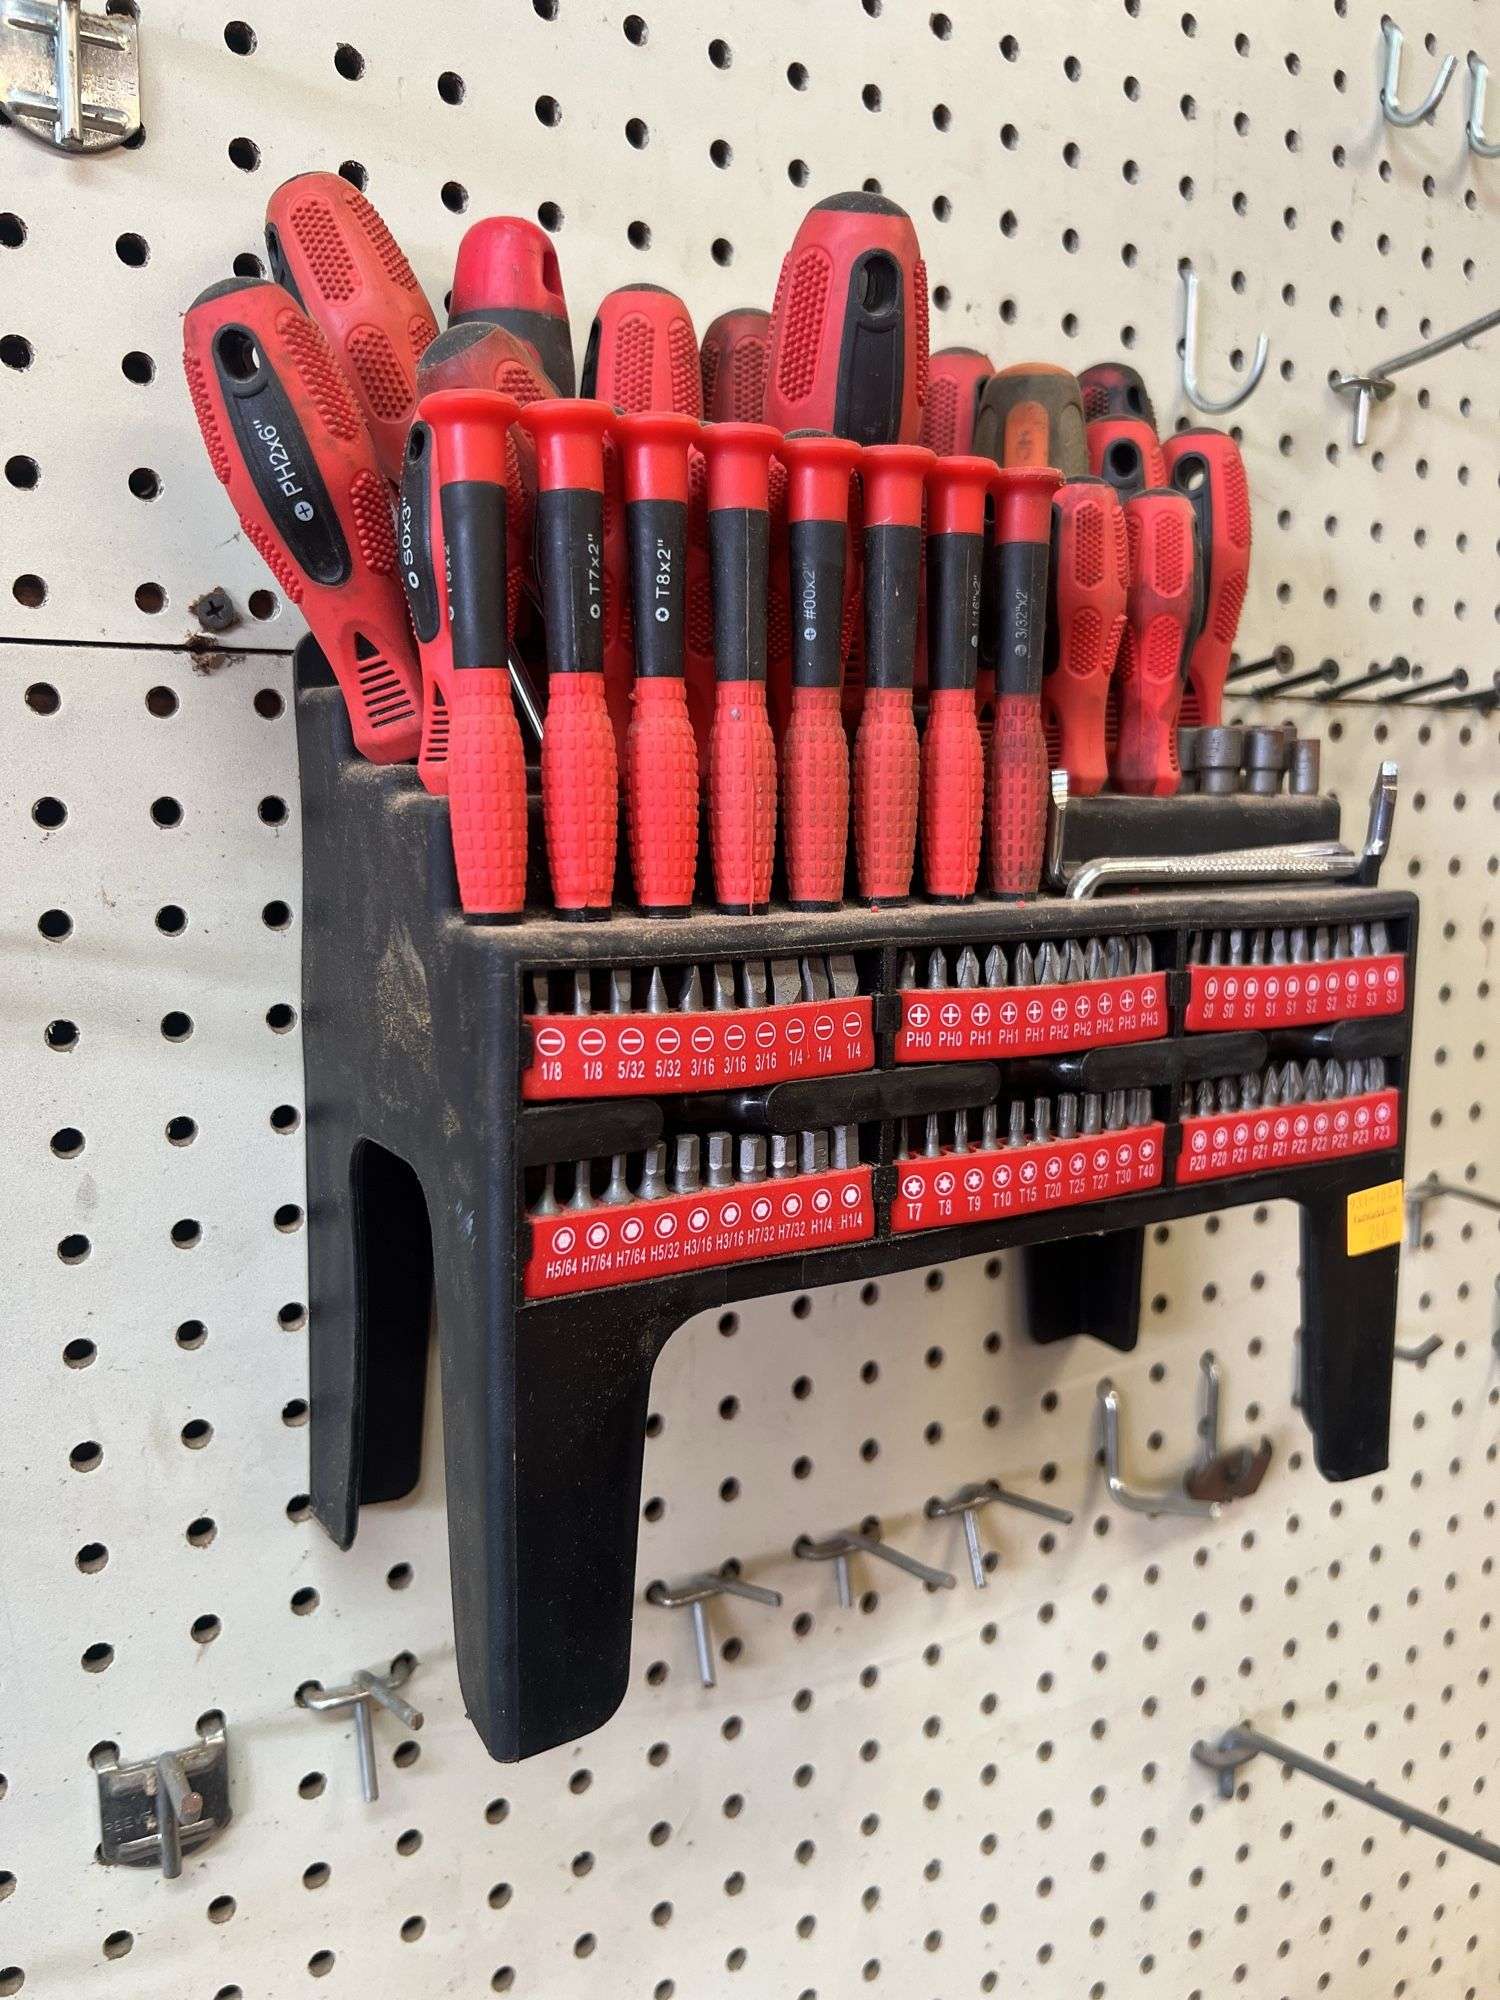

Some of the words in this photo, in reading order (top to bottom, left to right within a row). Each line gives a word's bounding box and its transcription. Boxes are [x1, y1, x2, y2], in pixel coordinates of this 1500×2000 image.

[253, 420, 303, 498] PH2x6"
[588, 533, 600, 595] T7x2"
[656, 539, 671, 599] T8x2"
[906, 1032, 931, 1047] PH0
[938, 1032, 962, 1047] PH0
[970, 1031, 991, 1045] PH1
[999, 1029, 1018, 1044] PH1
[1025, 1027, 1044, 1042] PH1
[1050, 1025, 1068, 1040] PH2
[1074, 1022, 1091, 1038] PH2
[1096, 1019, 1113, 1034] PH2
[1119, 1016, 1135, 1030] PH3
[1141, 1012, 1158, 1027] PH3
[542, 1061, 562, 1080] 1/8
[583, 1061, 603, 1080] 1/8
[618, 1061, 644, 1079] 5/32
[656, 1060, 681, 1077] 5/32
[691, 1057, 715, 1076] 3/16
[724, 1055, 746, 1073] 3/16
[755, 1053, 776, 1071] 3/16
[789, 1048, 803, 1065] 1/4
[818, 1046, 832, 1062] 1/4
[847, 1042, 861, 1058] 1/4
[907, 1203, 922, 1221] T7
[939, 1199, 951, 1215] T8
[968, 1196, 981, 1212] T9
[993, 1192, 1011, 1208] T10
[1019, 1187, 1036, 1203] T15
[1045, 1183, 1061, 1199] T20
[1069, 1179, 1085, 1194] T25
[1093, 1174, 1108, 1190] T27
[1116, 1169, 1131, 1185] T30
[1138, 1164, 1154, 1179] T40
[546, 1258, 577, 1279] H5/64
[582, 1253, 612, 1273] H7/64
[616, 1248, 646, 1267] H7/64
[650, 1242, 679, 1262] H5/32
[684, 1236, 712, 1256] H3/16
[716, 1232, 744, 1251] H3/16
[748, 1227, 774, 1245] H7/32
[778, 1222, 805, 1240] H7/32
[811, 1216, 832, 1234] H1/4
[841, 1212, 862, 1228] H1/4
